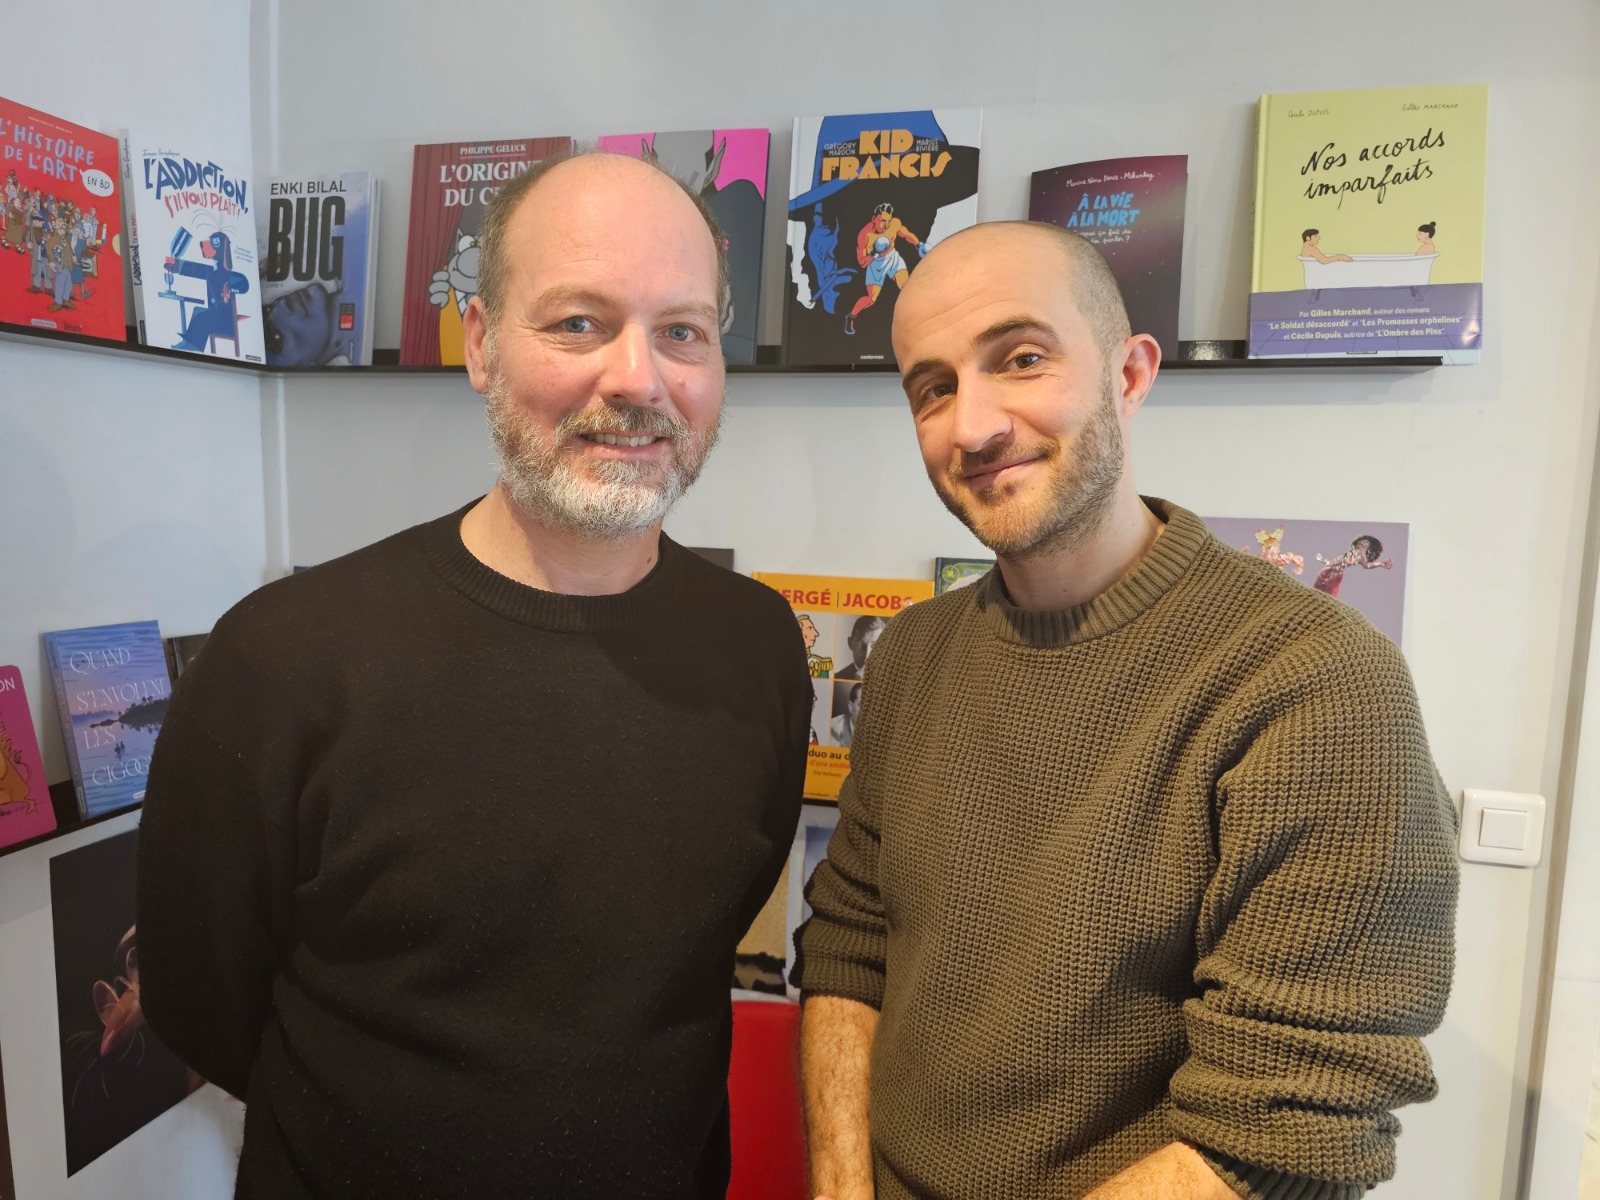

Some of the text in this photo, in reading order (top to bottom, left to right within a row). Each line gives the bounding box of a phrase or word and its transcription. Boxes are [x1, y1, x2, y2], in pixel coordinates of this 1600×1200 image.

[460, 144, 526, 155] PHILIPPE GELUCK
[859, 128, 914, 155] KID
[1301, 127, 1445, 176] Nos accords
[5, 145, 77, 182] DE L'ART
[440, 160, 543, 183] L'ORIGIN
[822, 151, 953, 181] FRANCIS
[87, 176, 110, 190] EN BD
[270, 180, 347, 195] ENKI BILAL
[1303, 158, 1433, 210] imparfaits
[164, 193, 184, 219] S'IL
[182, 190, 208, 209] VOUS
[444, 188, 474, 207] DU
[1093, 194, 1108, 210] LA
[1110, 191, 1134, 209] VIE
[1080, 211, 1094, 227] LA
[1096, 209, 1140, 228] MORT
[267, 196, 345, 282] BUG
[1310, 309, 1332, 317] Gilles
[1333, 307, 1372, 316] Marchand,
[1280, 321, 1305, 330] Soldat
[1377, 316, 1419, 326] Promesses
[1291, 331, 1314, 340] Cécile
[1315, 331, 1342, 340] Dupuis,
[1343, 331, 1365, 339] autrice
[1410, 328, 1424, 336] des
[778, 588, 831, 606] ERGÉ
[70, 647, 131, 675] QUAND
[84, 725, 116, 750] LES
[808, 749, 827, 758] duo
[829, 752, 842, 760] au
[92, 754, 152, 786] CIGOG
